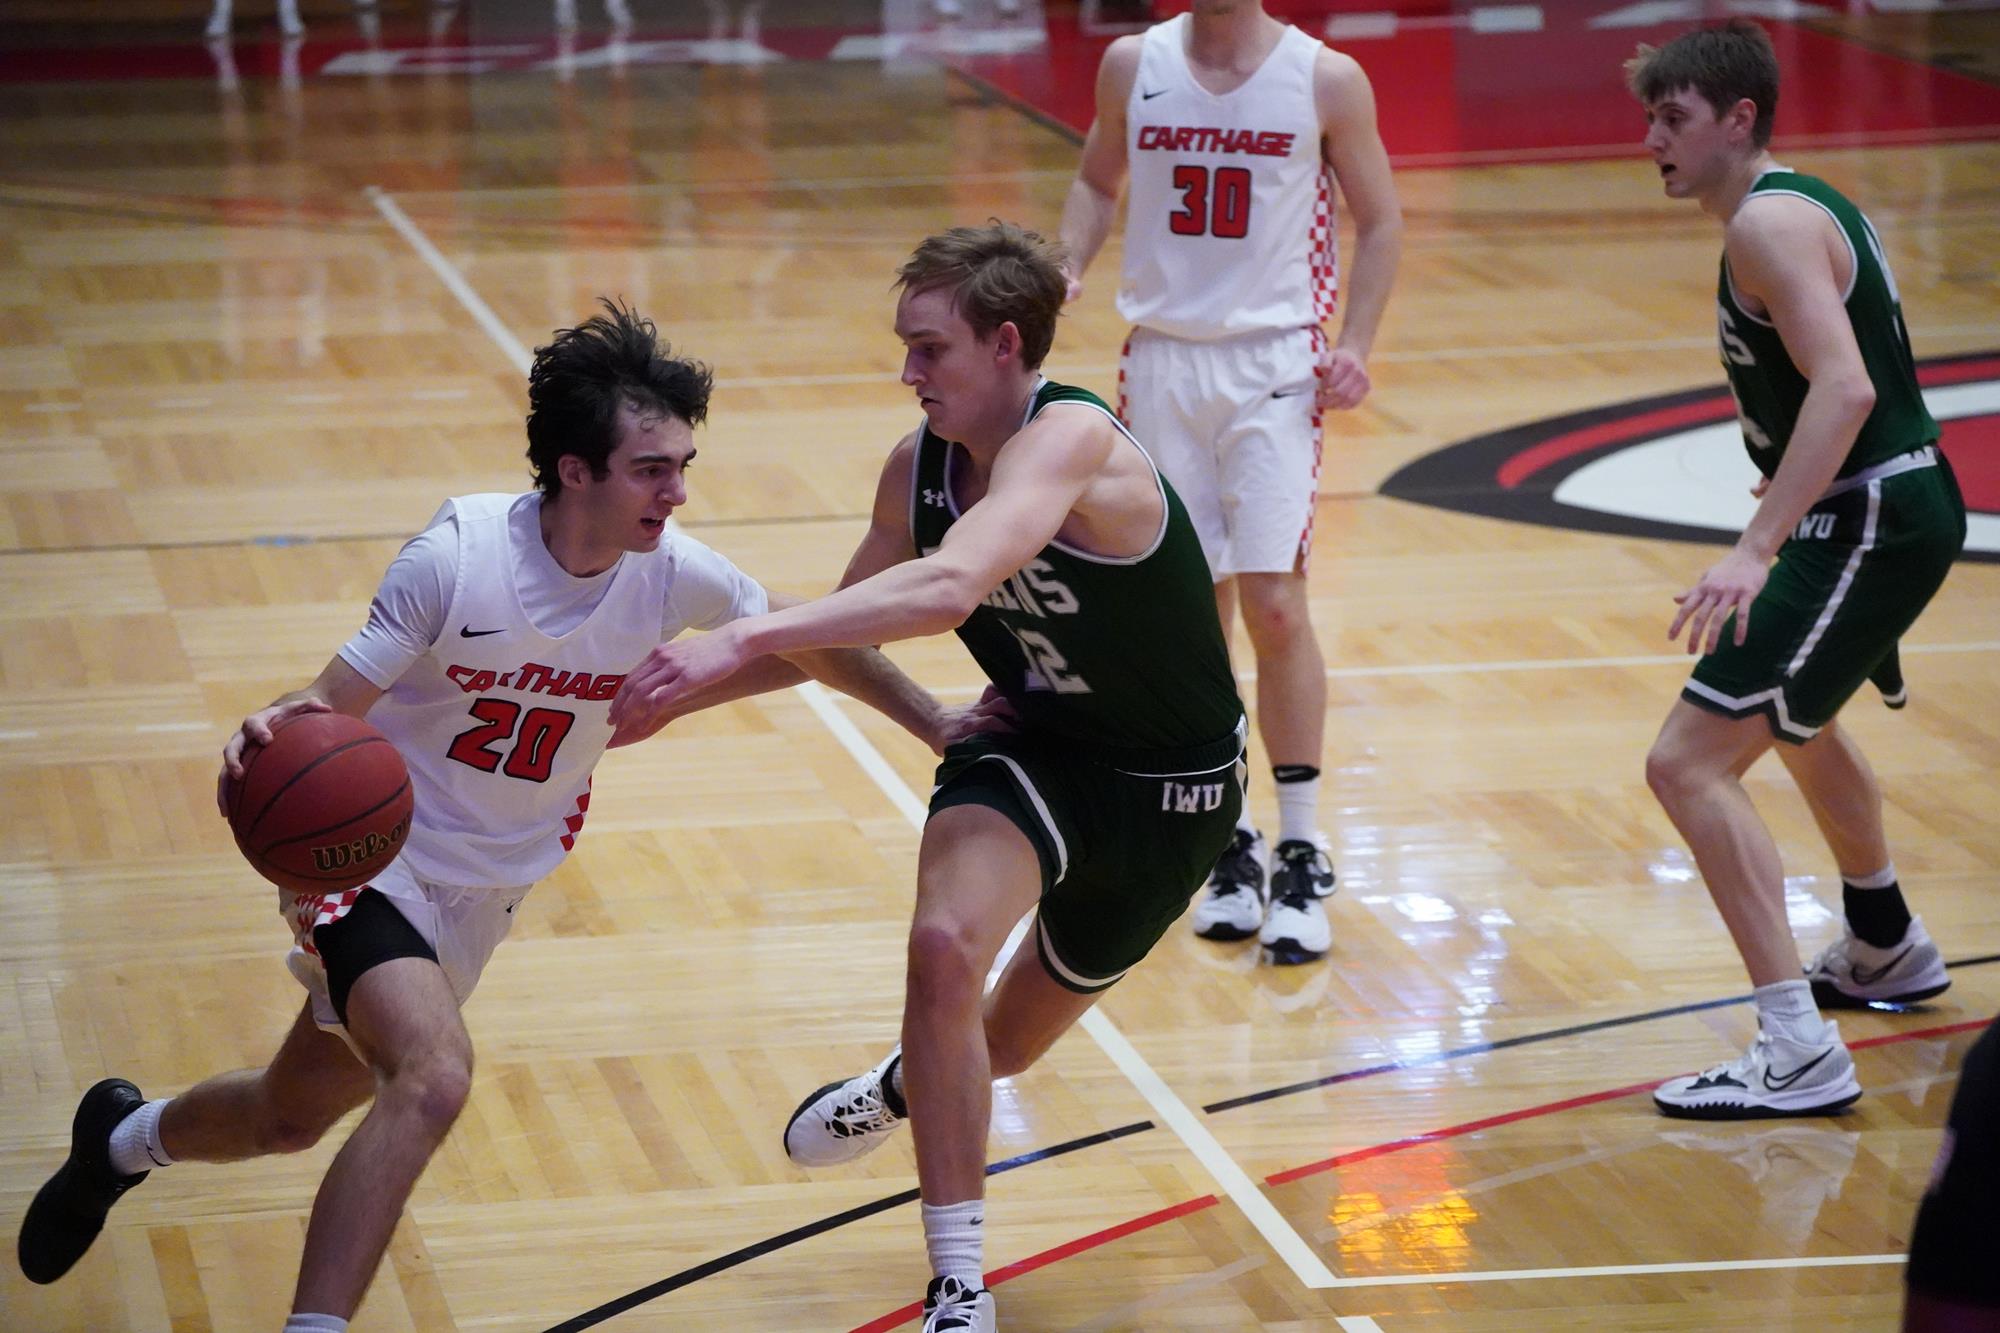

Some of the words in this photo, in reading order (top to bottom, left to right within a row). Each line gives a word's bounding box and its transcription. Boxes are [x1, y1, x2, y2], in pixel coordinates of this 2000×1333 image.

[1138, 126, 1296, 157] CARTHAGE
[1170, 165, 1251, 239] 30
[446, 662, 628, 701] CATHAG
[446, 698, 576, 783] 20
[1161, 782, 1225, 813] IWU
